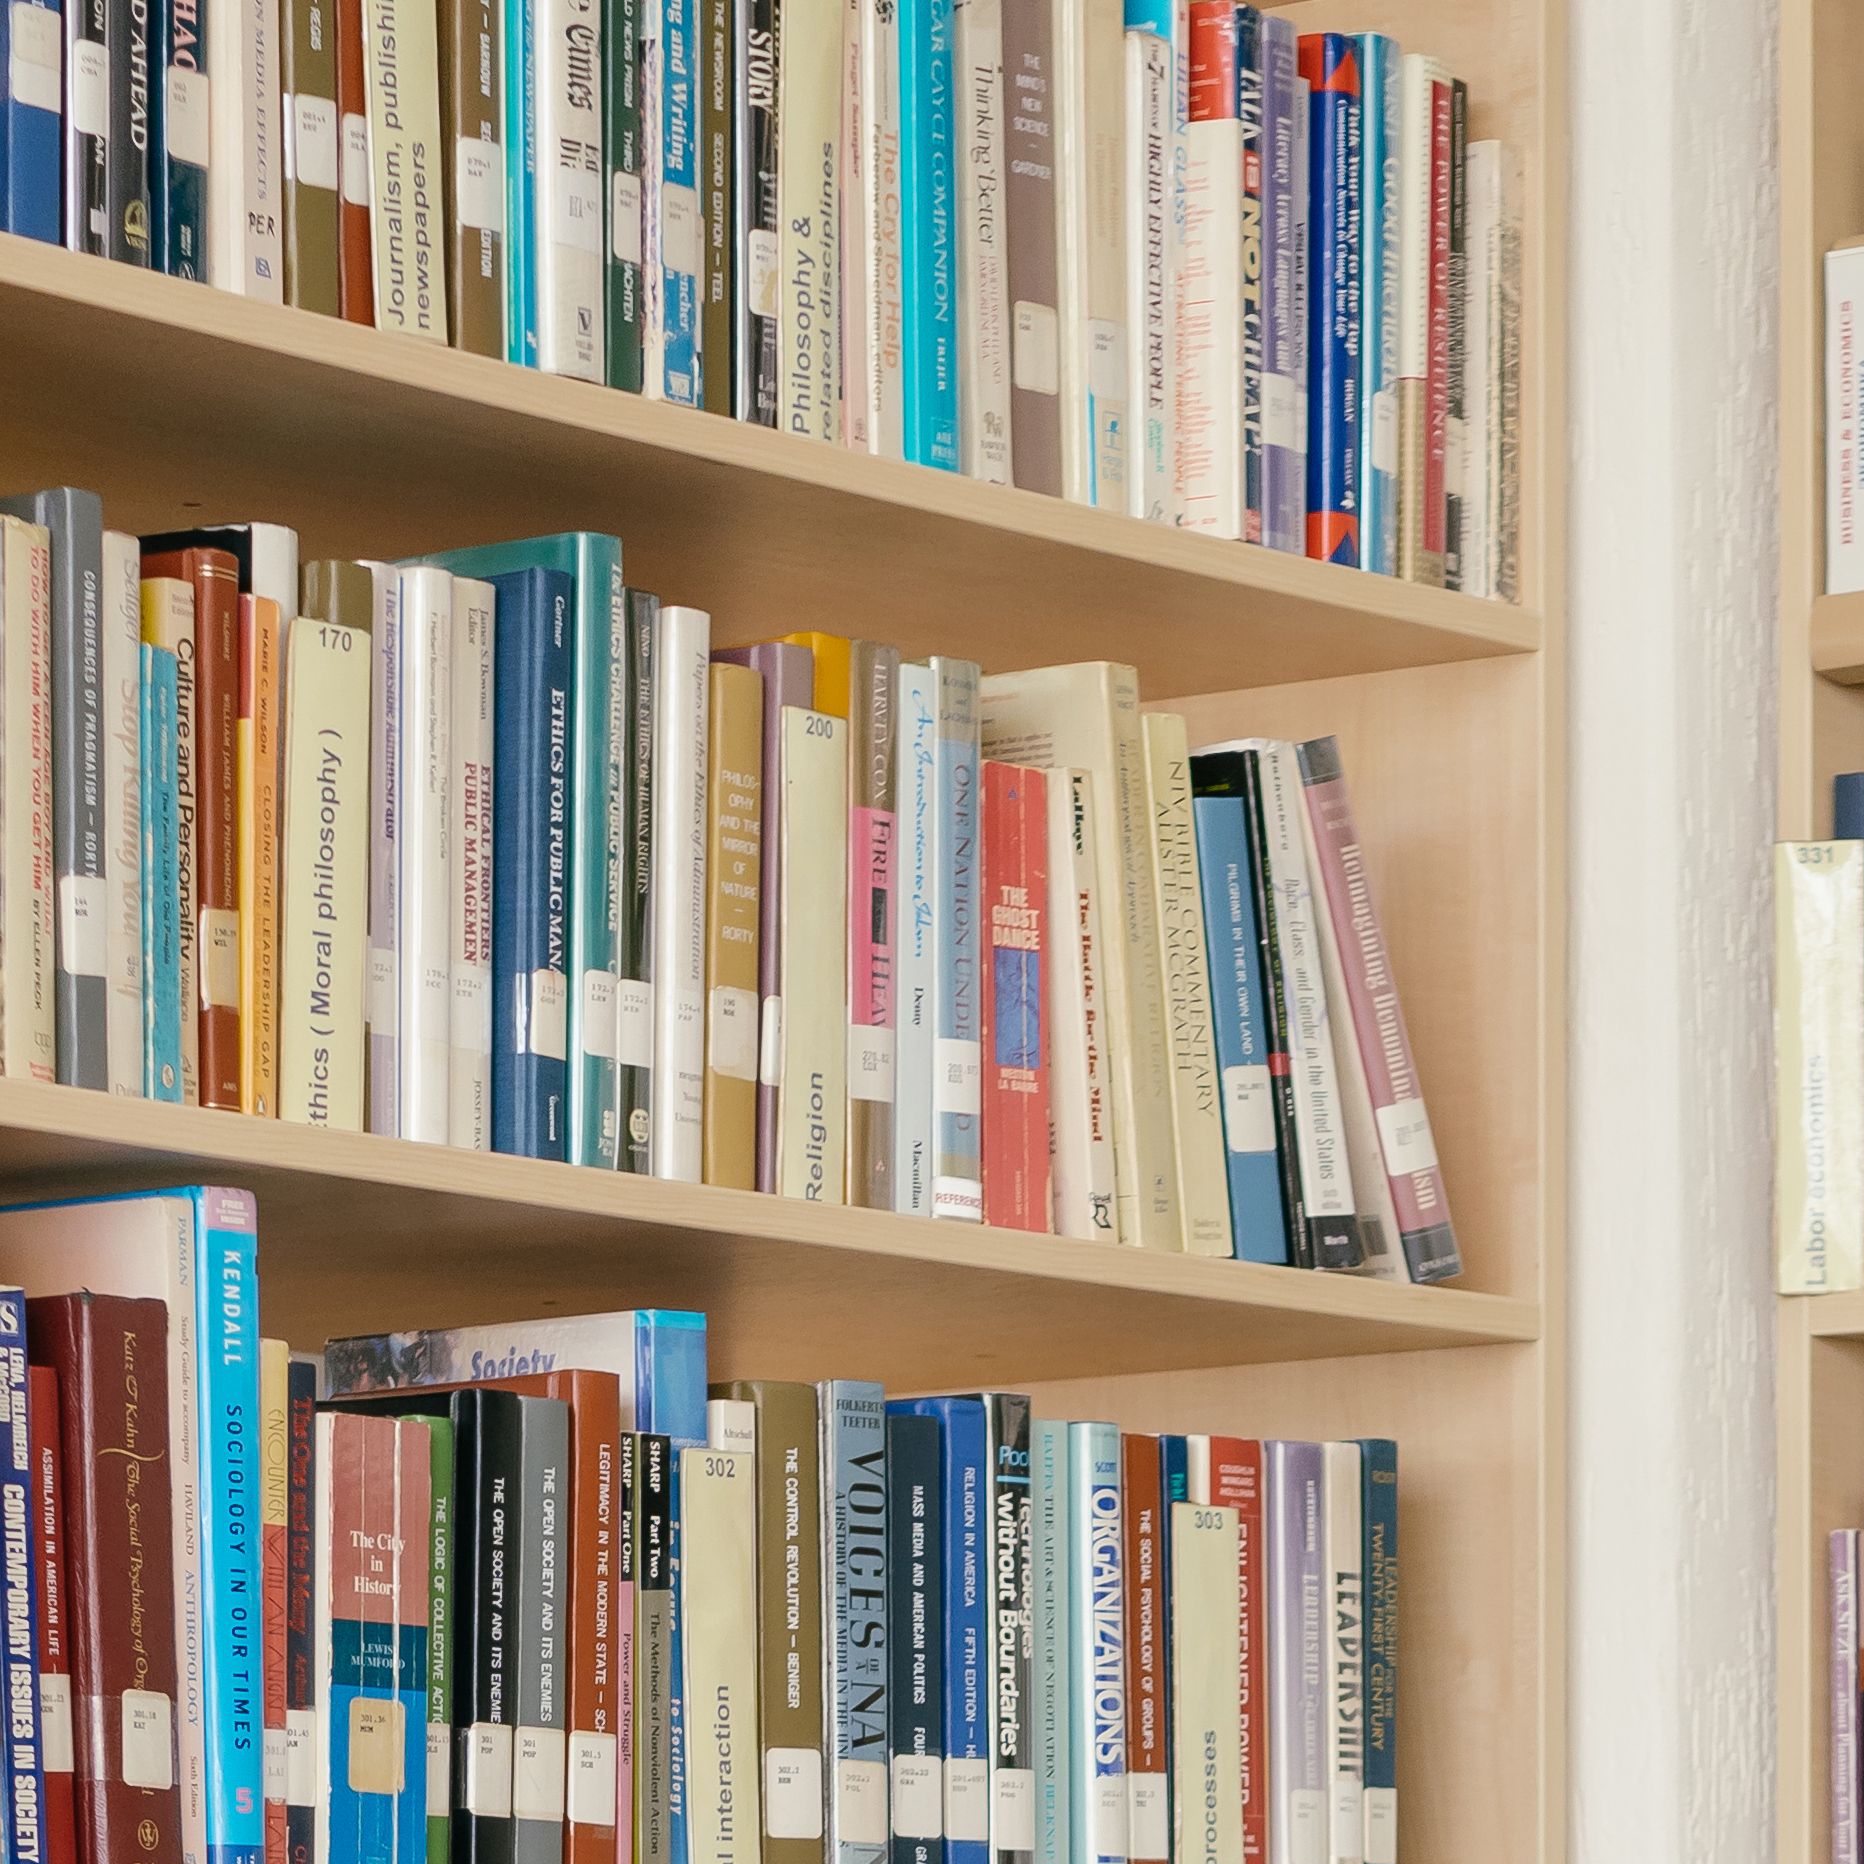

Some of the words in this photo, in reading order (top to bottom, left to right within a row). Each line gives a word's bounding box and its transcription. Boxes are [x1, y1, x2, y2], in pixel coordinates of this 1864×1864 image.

[376, 0, 403, 131] publishi
[248, 210, 276, 238] PER
[384, 142, 405, 328] Journalism,
[410, 141, 432, 330] newspapers
[793, 216, 813, 237] &
[819, 141, 837, 320] disciplines
[792, 246, 815, 436] Philosophy
[1839, 299, 1853, 420] ECONOMICS
[819, 329, 837, 440] related
[1840, 447, 1853, 546] BUSINESS
[319, 628, 353, 653] 170
[177, 637, 194, 738] Culture
[806, 716, 835, 740] 200
[177, 741, 195, 799] and
[313, 749, 343, 923] philosophy
[1797, 846, 1836, 864] 331
[992, 906, 1040, 928] GHOST
[1000, 885, 1030, 906] THE
[311, 933, 333, 1016] Moral
[992, 928, 1041, 950] DANCE
[309, 1048, 328, 1131] thics
[804, 1072, 826, 1201] Religion
[1806, 1203, 1827, 1286] Labor
[222, 1251, 241, 1368] KENDALL
[225, 1404, 246, 1554] SOCIOLOGY
[649, 1441, 661, 1492] SHARP
[705, 1457, 737, 1478] 302
[350, 1531, 378, 1550] The
[380, 1531, 406, 1553] City
[649, 1515, 660, 1545] Part
[996, 1492, 1016, 1601] without
[1194, 1511, 1224, 1530] 303
[231, 1570, 246, 1593] IN
[354, 1577, 400, 1598] History
[371, 1557, 384, 1573] in
[649, 1549, 660, 1580] Two
[231, 1607, 248, 1659] OUR
[1090, 1488, 1124, 1766] ORGANIZATIONS
[232, 1670, 250, 1752] TIMES
[998, 1609, 1017, 1756] Boundaries
[235, 1787, 251, 1814] 5
[716, 1685, 737, 1843] interaction
